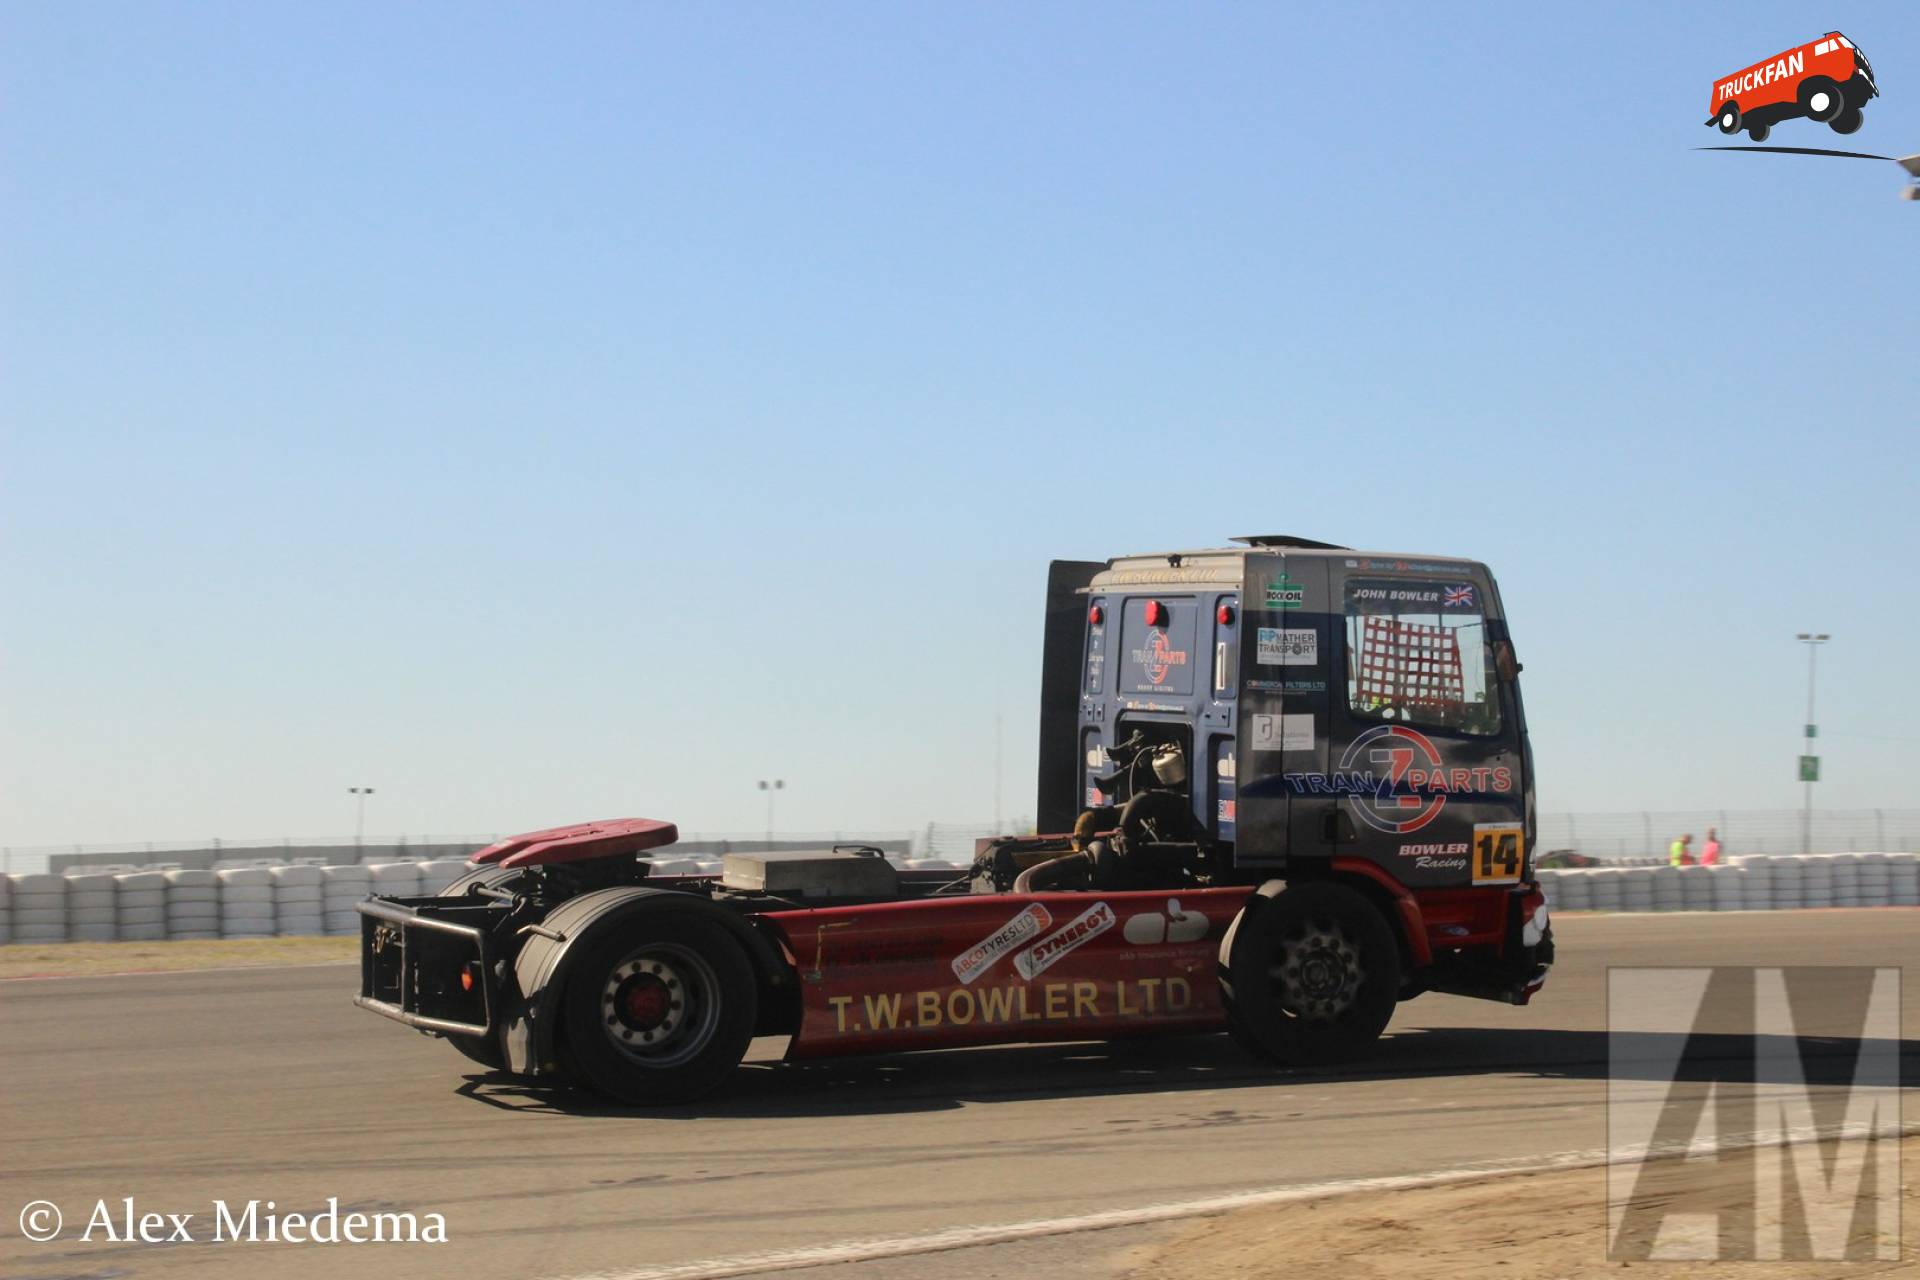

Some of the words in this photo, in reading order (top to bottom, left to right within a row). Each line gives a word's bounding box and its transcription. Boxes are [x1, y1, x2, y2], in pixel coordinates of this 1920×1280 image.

[1353, 588, 1387, 599] JOHN
[1389, 590, 1439, 602] BOWLER
[1399, 843, 1468, 856] BOWLER
[1477, 834, 1520, 876] 14
[1415, 856, 1467, 870] Racing
[1033, 907, 1108, 961] SYNERGY
